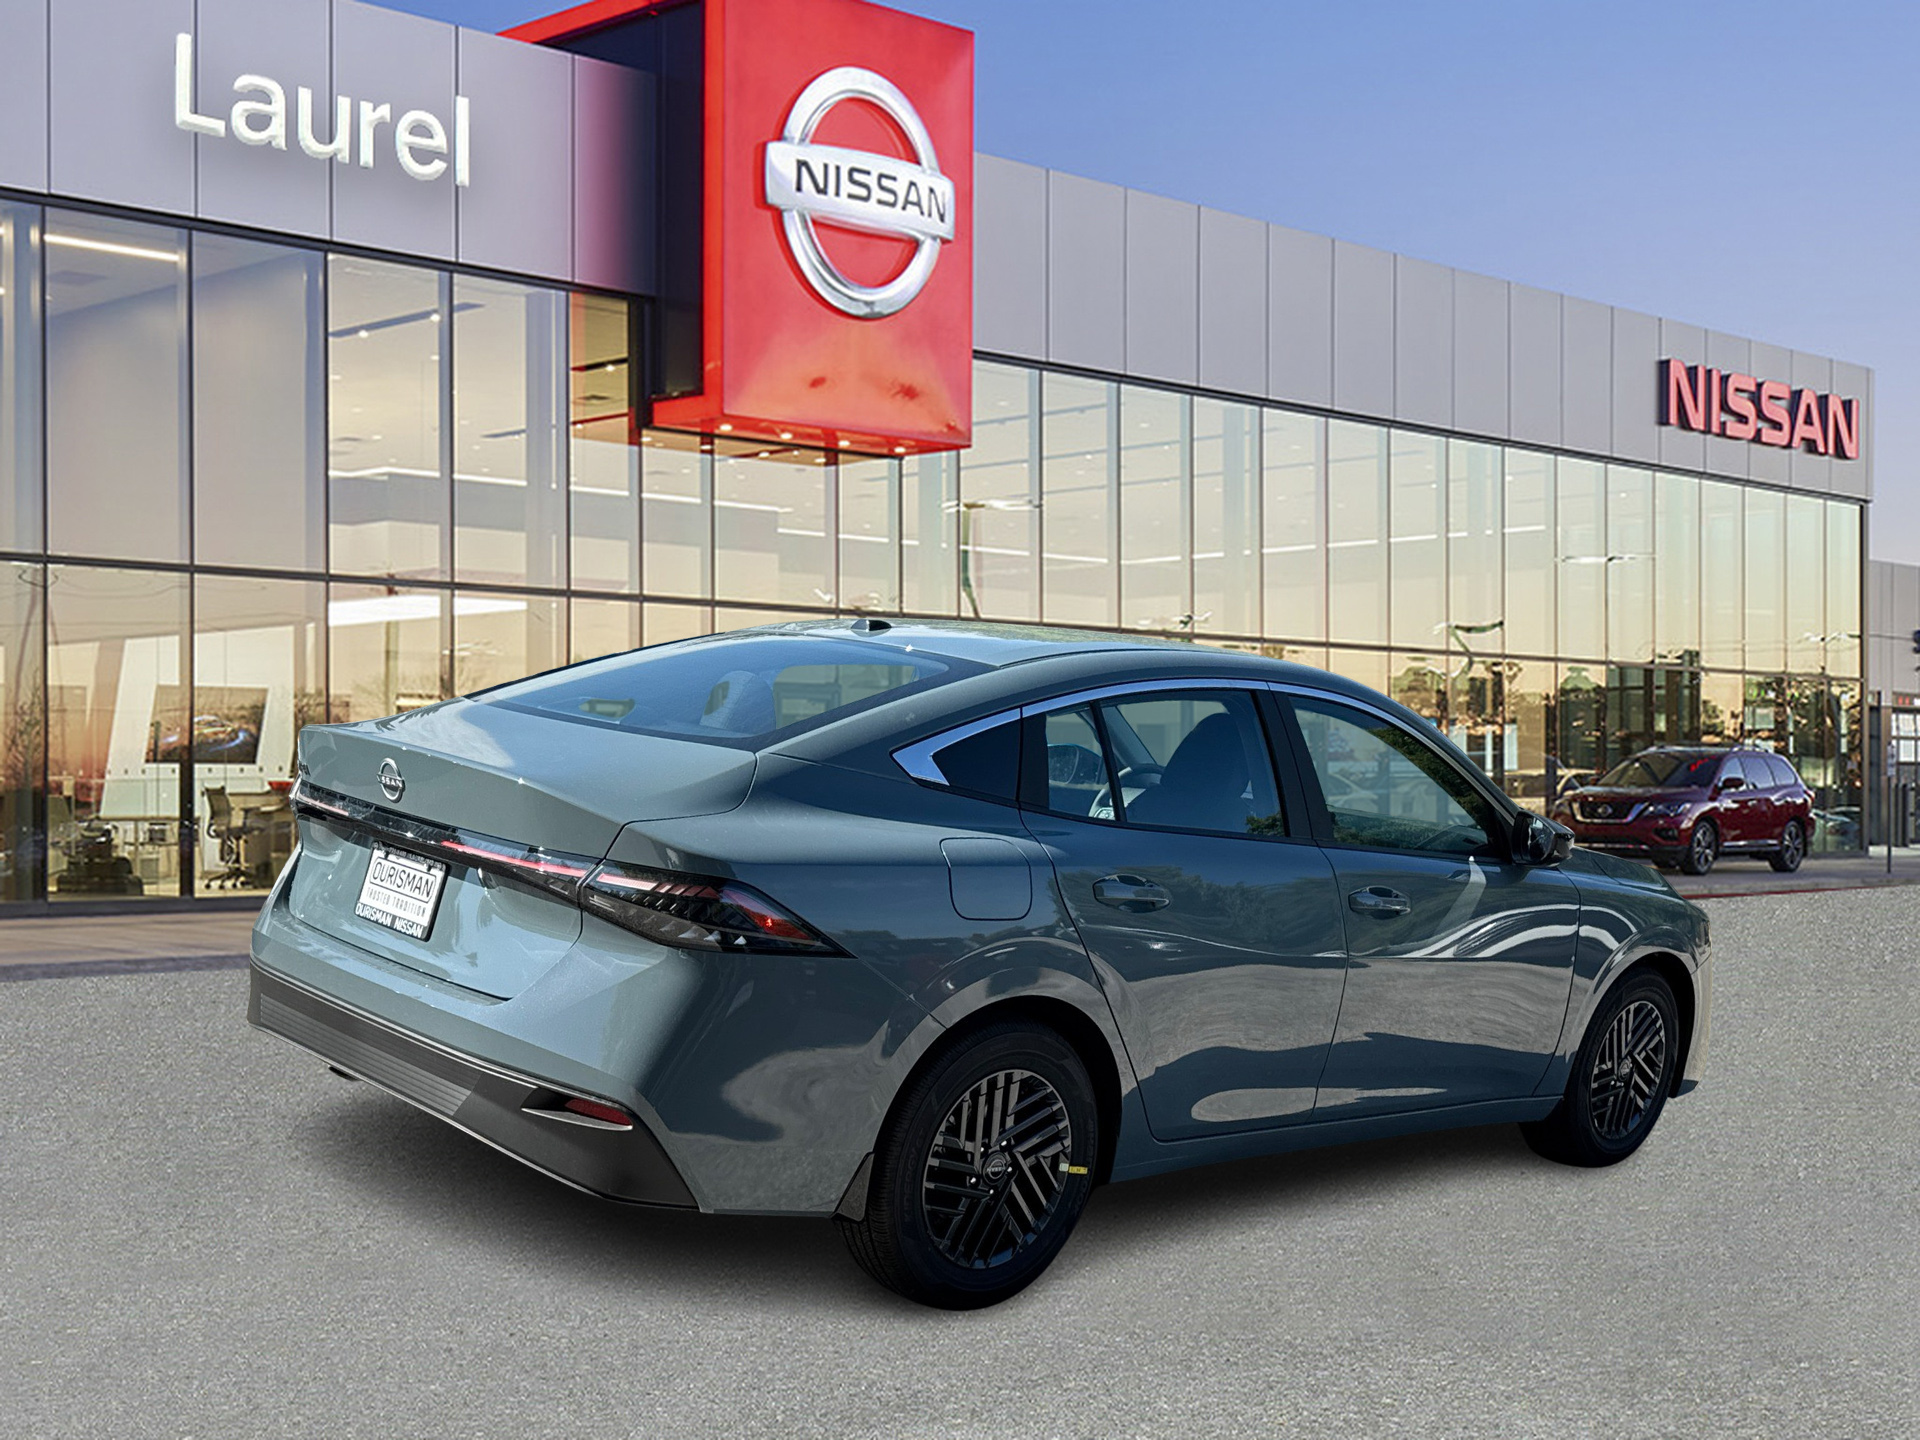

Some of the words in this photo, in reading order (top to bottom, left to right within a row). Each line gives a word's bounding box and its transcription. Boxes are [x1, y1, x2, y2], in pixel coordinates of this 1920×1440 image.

[175, 32, 470, 188] Laurel
[795, 158, 946, 224] NISSAN
[1658, 358, 1860, 460] NISSAN
[366, 887, 390, 906] TRUSTED
[372, 861, 434, 898] OURISMAN
[355, 902, 393, 927] OURISMAN
[393, 916, 424, 938] NISSAN
